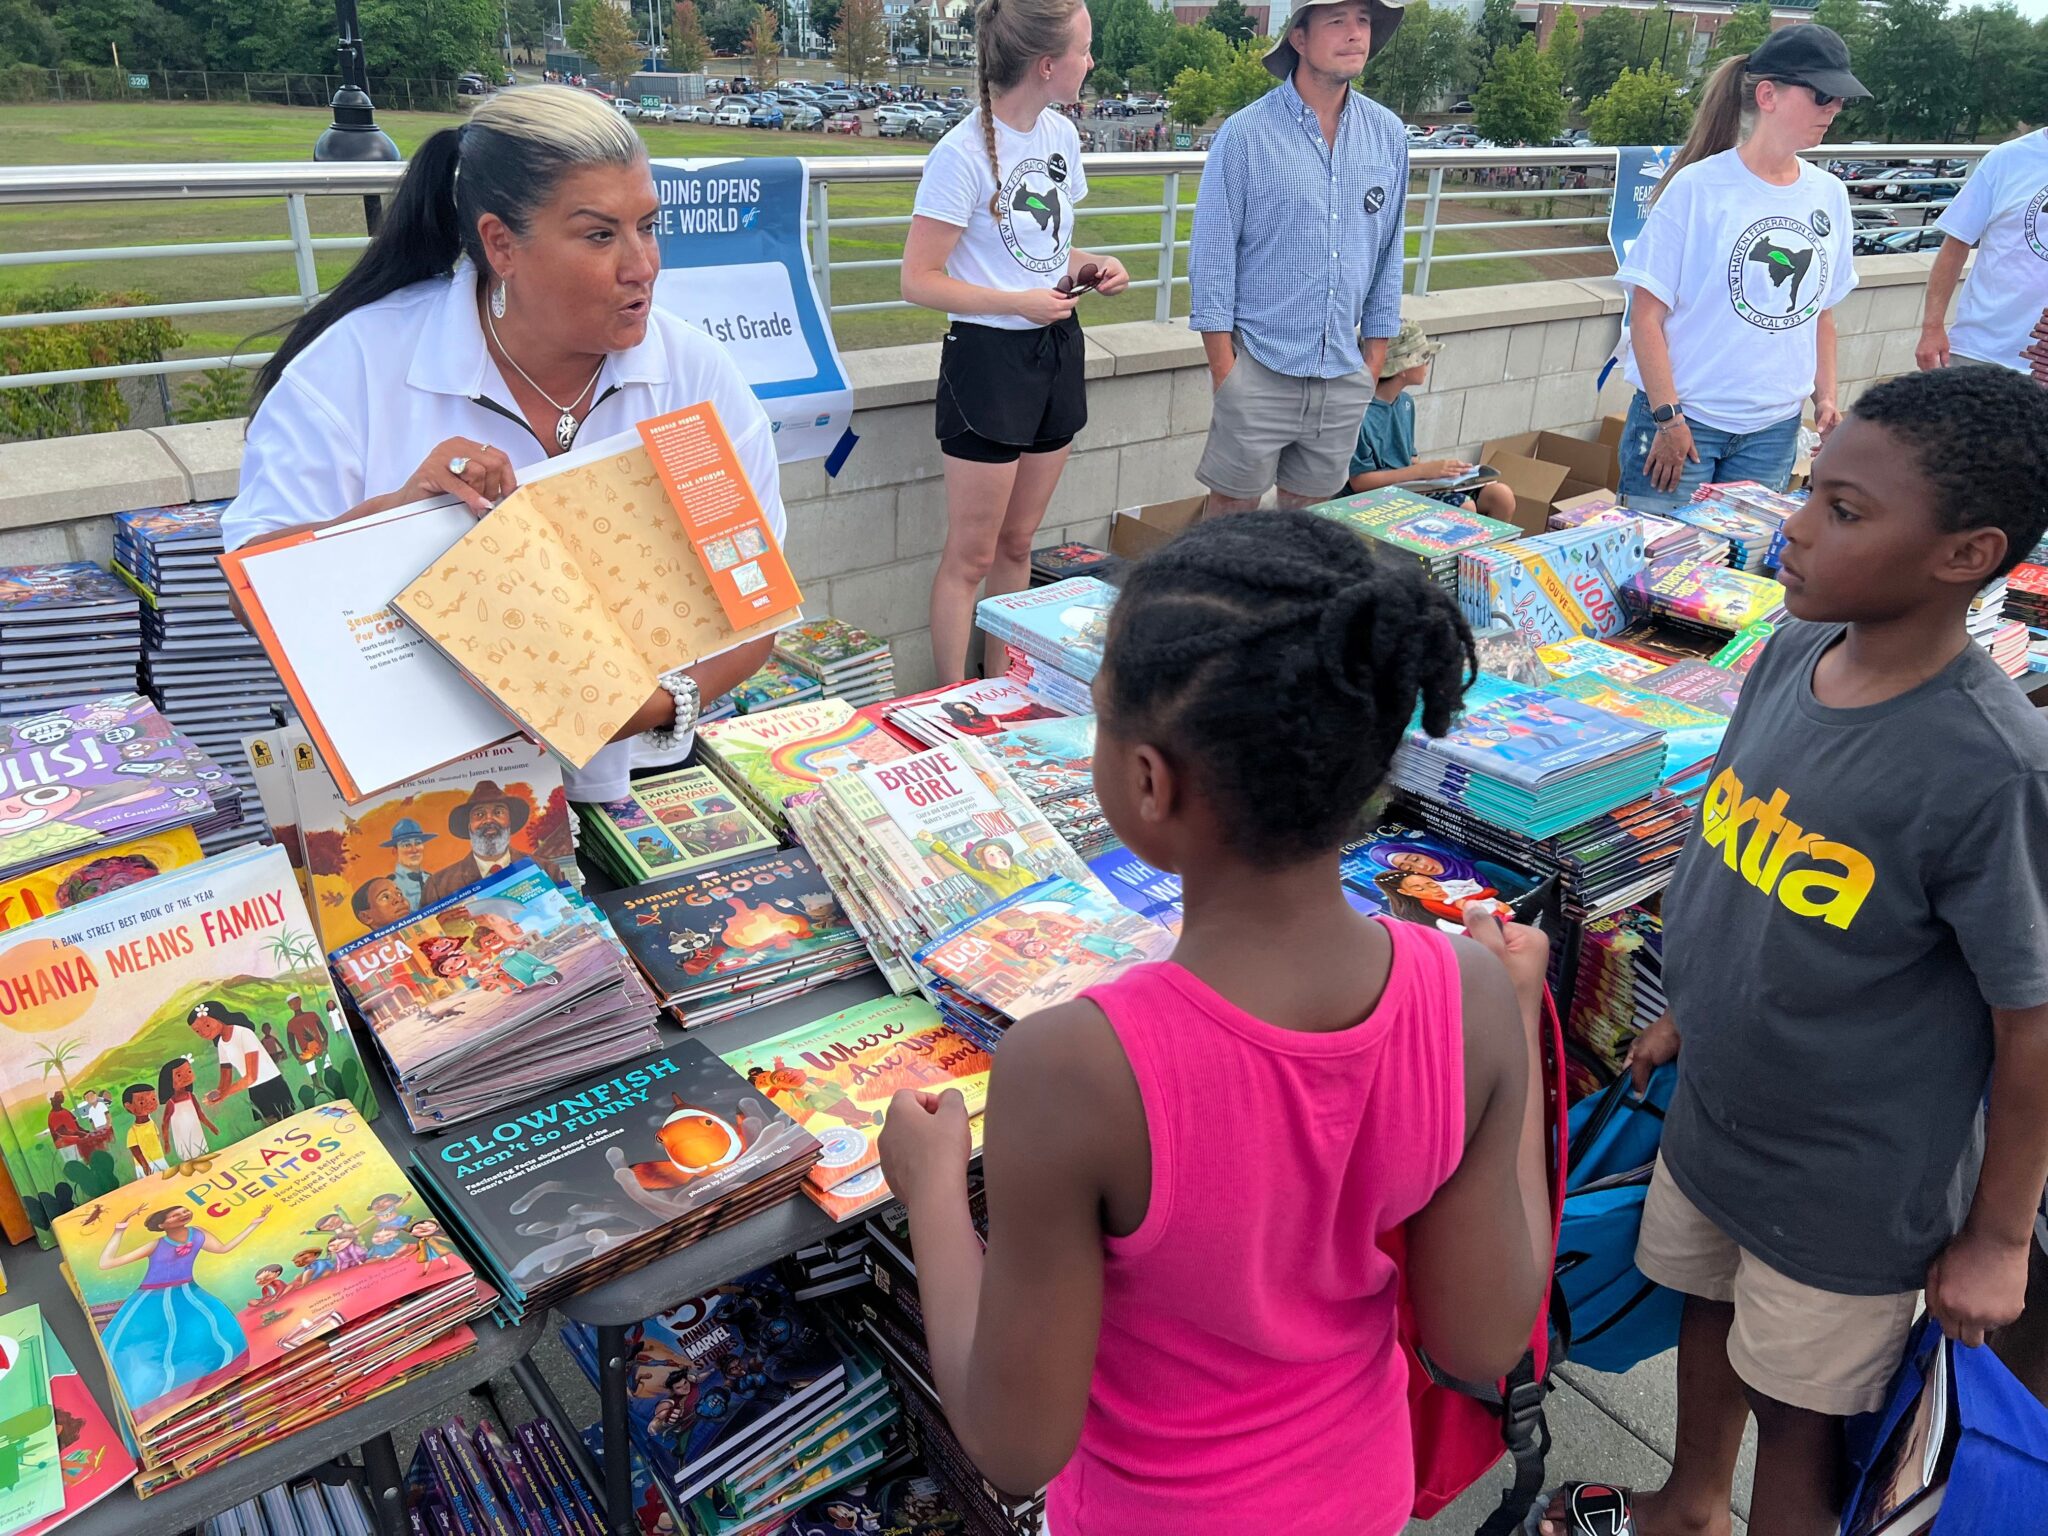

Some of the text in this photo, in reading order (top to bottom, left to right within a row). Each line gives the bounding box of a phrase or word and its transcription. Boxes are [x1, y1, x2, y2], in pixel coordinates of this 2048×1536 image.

[130, 77, 147, 86] 320
[642, 97, 659, 107] 365
[1176, 136, 1190, 146] 380
[655, 178, 760, 206] DING OPENS
[1000, 185, 1012, 220] HAVEN
[2026, 193, 2045, 221] HAVEN
[653, 210, 674, 235] HE
[680, 208, 738, 234] WORLD
[1001, 223, 1016, 249] NEW
[1748, 218, 1806, 238] FEDERATION
[1807, 232, 1821, 243] OF
[1025, 252, 1066, 271] LOCAL 933
[1731, 236, 1750, 273] HAVEN
[1732, 279, 1742, 301] NEW
[702, 311, 793, 343] 1st Grade
[1747, 311, 1801, 328] LOCAL 933
[1545, 576, 1569, 610] YOU'VE
[1575, 575, 1616, 634] Jobs
[355, 631, 374, 643] For
[361, 637, 397, 653] starts today!
[365, 650, 386, 661] There's
[965, 685, 1022, 707] MULAN
[740, 717, 768, 728] NEW
[771, 710, 803, 721] KIND
[752, 716, 820, 738] WILD
[492, 747, 514, 756] BOX
[469, 769, 489, 778] James
[498, 763, 529, 773] Ransome
[875, 752, 958, 791] BRAVE
[641, 780, 714, 801] EXPEDITION
[645, 785, 719, 808] BACKYARD
[904, 776, 963, 807] GIRL
[94, 803, 170, 826] Scott Campbell
[1420, 800, 1462, 821] HIDDEN FIGURES
[1421, 811, 1462, 832] HIDDEN FIGURES
[1702, 766, 1876, 930] extra
[623, 859, 785, 910] Summer Adventure
[651, 859, 810, 911] For GROOT!
[52, 889, 215, 950] A BANK STREET BEST BOOK OF THE YEAR
[338, 936, 372, 956] PIXAR
[374, 913, 422, 938] Read-Along
[422, 897, 456, 916] STORYBOOK
[457, 889, 472, 901] AND
[0, 889, 286, 1016] OHANA MEANS FAMILY
[922, 917, 982, 956] PIXAR Read-Along
[348, 940, 414, 982] LUCA
[936, 937, 992, 973] LUCA
[790, 1030, 829, 1049] YAMILE
[834, 1019, 865, 1035] SAIED
[799, 1022, 905, 1072] Where
[848, 1026, 956, 1085] Are You
[441, 1058, 680, 1162] CLOWNFISH
[456, 1089, 650, 1178] Aren't So FUNNY
[185, 1127, 312, 1206] PURA'S
[465, 1168, 514, 1191] Fascinating
[514, 1159, 536, 1171] Facts
[537, 1148, 559, 1162] about
[561, 1139, 584, 1151] Some
[594, 1128, 608, 1137] the
[470, 1128, 624, 1196] Ocean's Most Misunderstood Creatures
[206, 1136, 341, 1217] CUENTOS
[273, 1184, 293, 1198] How
[294, 1170, 317, 1187] Pura
[280, 1150, 366, 1203] Reshaped Libraries
[288, 1162, 363, 1208] with Her Stories
[688, 1184, 710, 1198] photos
[685, 1327, 731, 1360] MARVEL
[693, 1338, 738, 1370] STORIES
[475, 1482, 500, 1519] Bedtime
[505, 1492, 530, 1529] Bedtime
[553, 1485, 578, 1522] Bedtime
[571, 1478, 596, 1515] Bedtime
[451, 1494, 478, 1533] Bedtime
